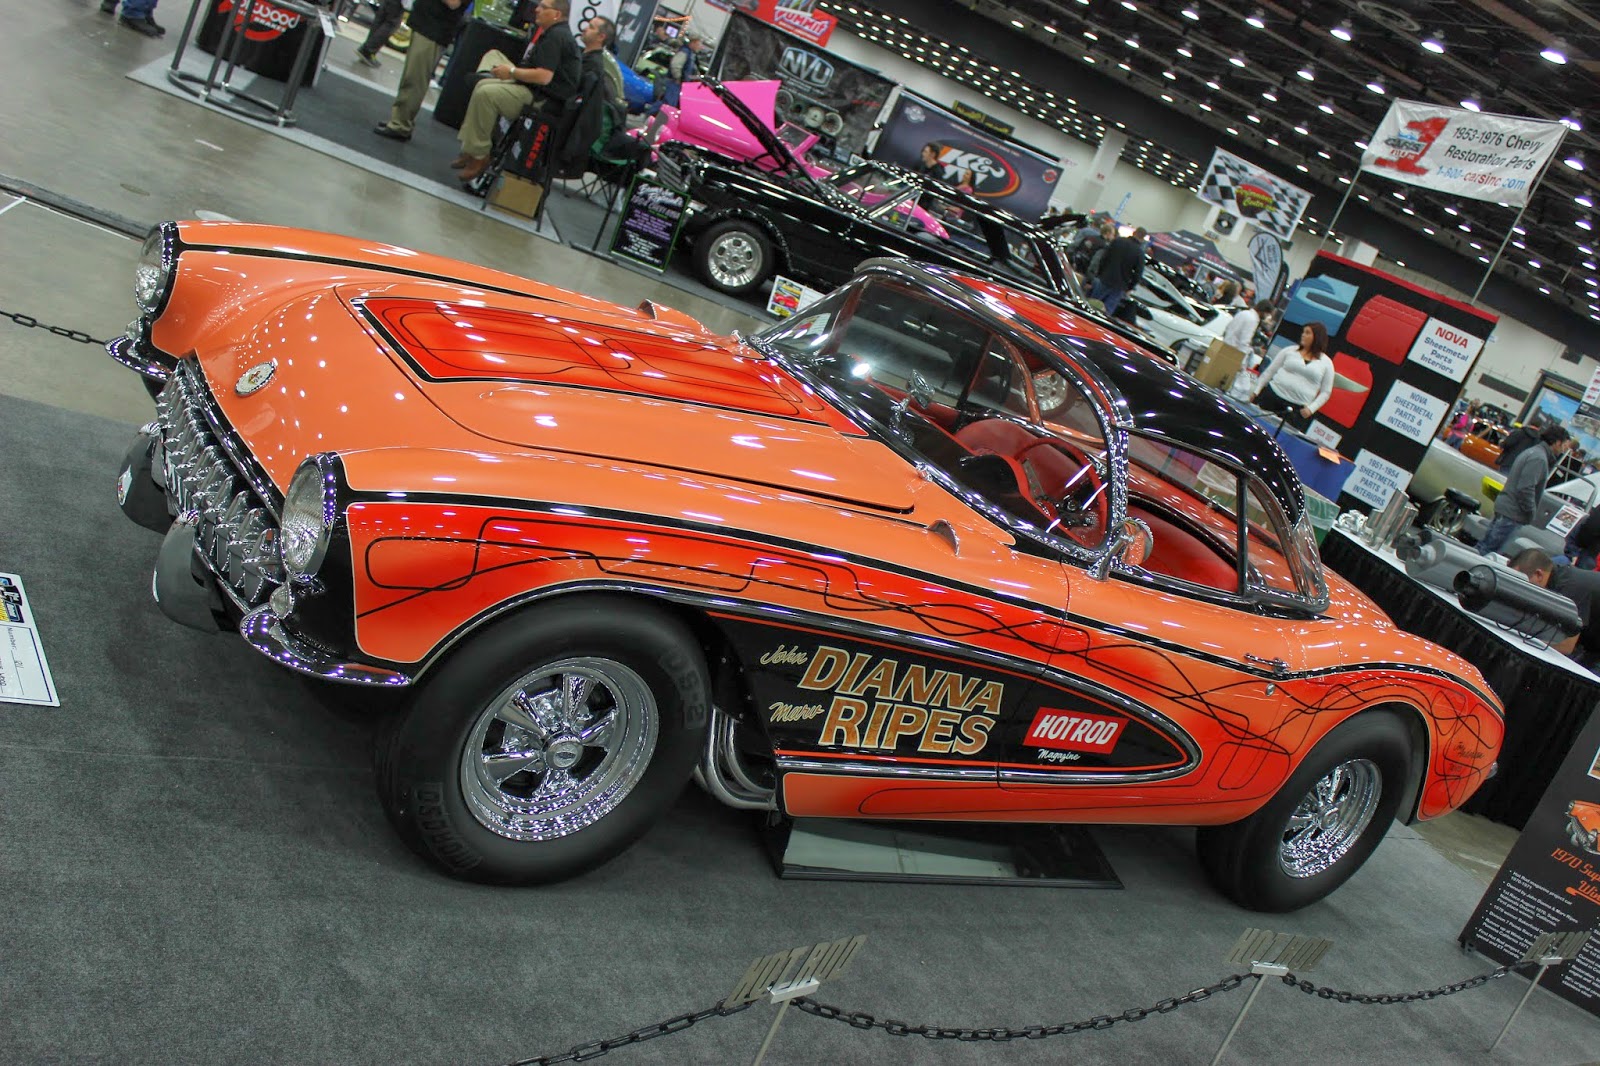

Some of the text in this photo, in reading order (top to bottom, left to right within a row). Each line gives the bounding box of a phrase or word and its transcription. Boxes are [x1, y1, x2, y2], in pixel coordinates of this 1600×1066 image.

[783, 50, 830, 84] NVU
[1452, 127, 1544, 154] 1953-1976 Chevy
[1444, 145, 1536, 171] Restoration Parts
[1435, 326, 1469, 349] NOVA
[1424, 337, 1469, 362] Sheetmetal
[1430, 350, 1452, 365] Parts
[1420, 354, 1454, 374] Interiors
[1394, 397, 1433, 420] SHEETMETAL
[1410, 392, 1428, 405] NOVA
[1387, 416, 1421, 438] INTERIORS
[1394, 409, 1416, 423] PARTS
[1359, 465, 1398, 490] SHEETMETAL
[1360, 477, 1380, 492] PARTS
[1352, 485, 1386, 507] INTERIORS
[760, 644, 1004, 716] John DIANNA
[768, 695, 998, 756] Marv RIPES
[1032, 714, 1119, 745] HOT ROD
[1037, 748, 1081, 763] Magazine
[1551, 847, 1583, 869] 1970
[1549, 891, 1565, 901] project
